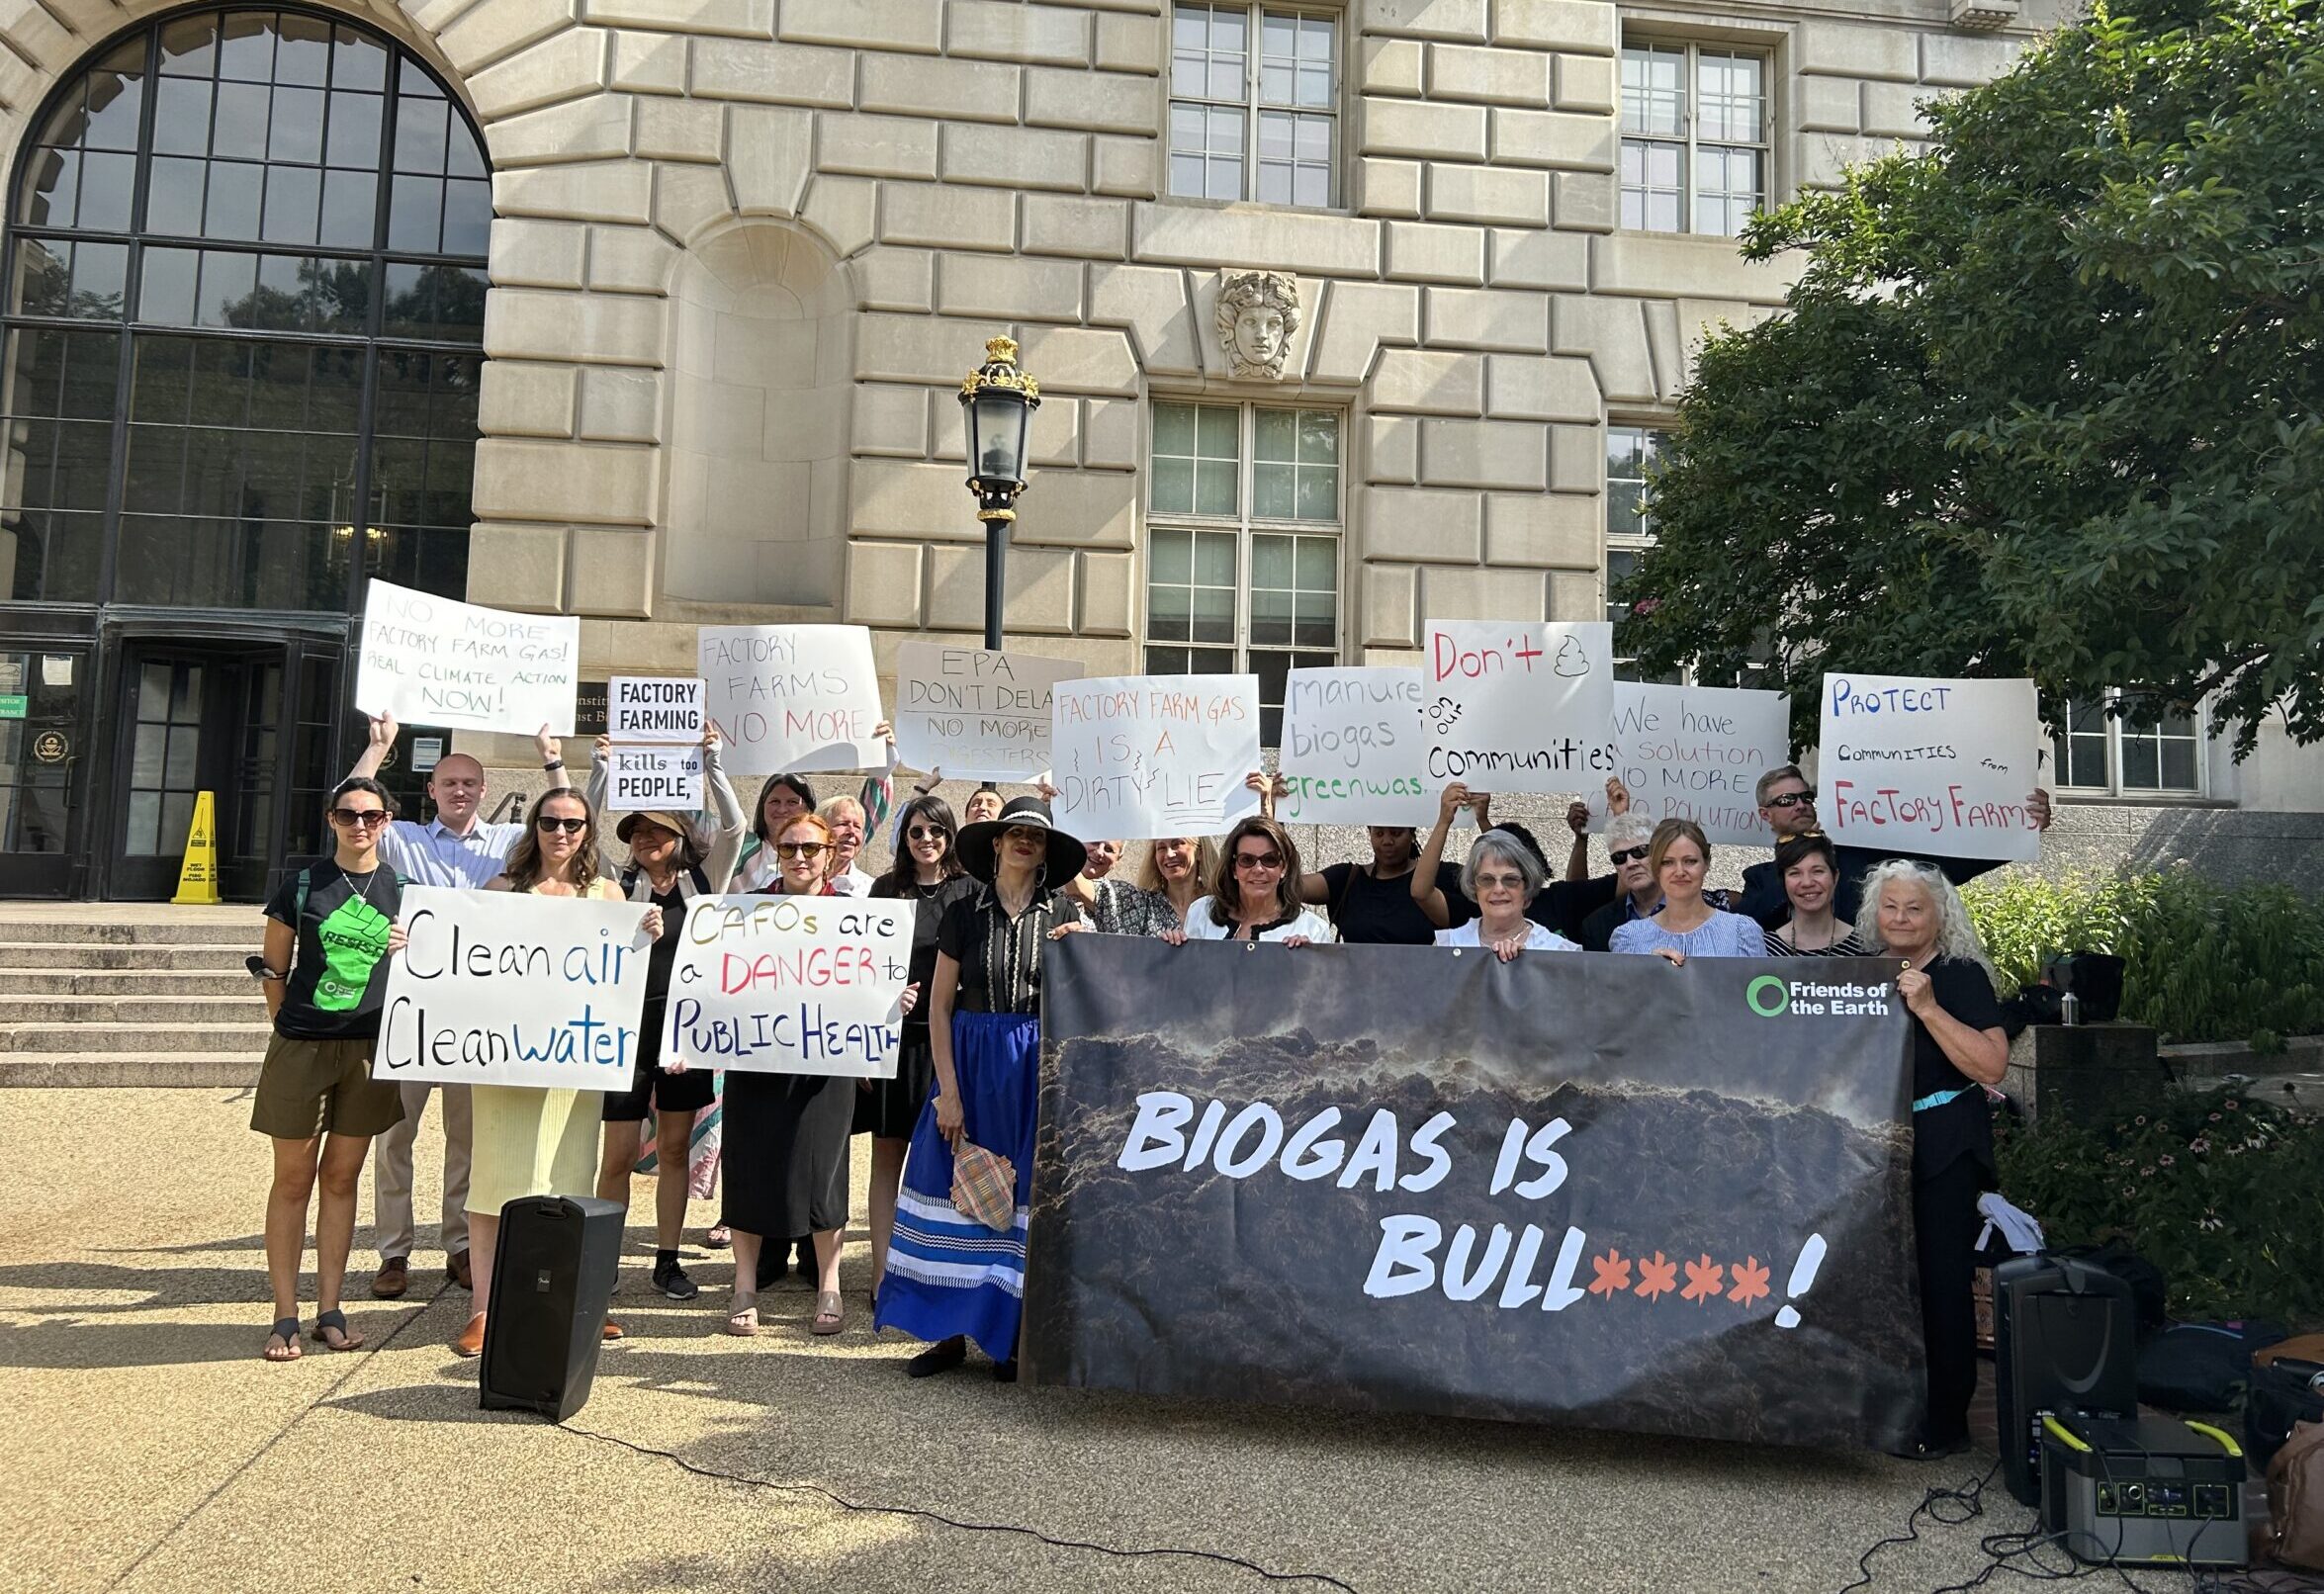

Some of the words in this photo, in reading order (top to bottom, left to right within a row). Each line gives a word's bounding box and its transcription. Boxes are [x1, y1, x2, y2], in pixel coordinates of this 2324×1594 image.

[388, 594, 432, 623] NO
[466, 617, 550, 640] MORE
[370, 621, 437, 653] FACTORY
[452, 639, 507, 659] FARM
[519, 643, 567, 662] GAS!
[704, 633, 795, 665] FACTORY
[1435, 633, 1543, 682] Don't
[367, 651, 404, 674] REAL
[418, 664, 496, 684] CLIMATE
[512, 671, 567, 684] ACTION
[942, 651, 1015, 680] EPA
[422, 687, 504, 713] NOW!
[620, 683, 696, 703] FACTORY
[728, 668, 848, 700] FARMS
[910, 680, 984, 709] DON'T
[997, 686, 1052, 709] DELA
[1293, 679, 1422, 715] manure
[578, 695, 607, 706] nstit
[1060, 690, 1139, 725] FACTORY
[1150, 692, 1200, 724] FARM
[1207, 695, 1245, 727] GAS
[1429, 697, 1453, 718] on
[1614, 696, 1659, 735] We
[1681, 699, 1737, 735] have
[620, 710, 698, 730] FARMING
[713, 713, 766, 747] NO
[786, 709, 865, 742] MORE
[929, 718, 963, 736] NO
[981, 720, 1047, 742] MORE
[1437, 703, 1463, 735] our
[1097, 734, 1130, 763] IS
[1154, 731, 1176, 757] A
[1292, 721, 1395, 768] biogas
[618, 753, 667, 770] kills
[680, 759, 697, 770] too
[1981, 758, 2009, 774] from
[618, 777, 690, 800] PEOPLE,
[1064, 773, 1143, 814] DIRTY
[1165, 771, 1224, 807] LIE
[1662, 767, 1749, 793] MORE
[1285, 776, 1425, 818] greenwas
[690, 901, 818, 944] CAFOs
[840, 913, 895, 936] are
[405, 909, 550, 979] Clean
[564, 929, 635, 986] air
[680, 964, 702, 984] a
[722, 946, 876, 995] DANGER
[882, 955, 908, 981] to
[1790, 982, 1864, 997] Friends
[1867, 982, 1888, 998] of
[1790, 1000, 1825, 1015] the
[1831, 1000, 1889, 1016] Earth
[386, 996, 508, 1069] Clean
[513, 1004, 637, 1068] water
[672, 999, 794, 1057] PUBLIC
[801, 1003, 900, 1062] HEALTH
[1117, 1091, 1457, 1193] BIOGAS
[1489, 1116, 1572, 1200] IS
